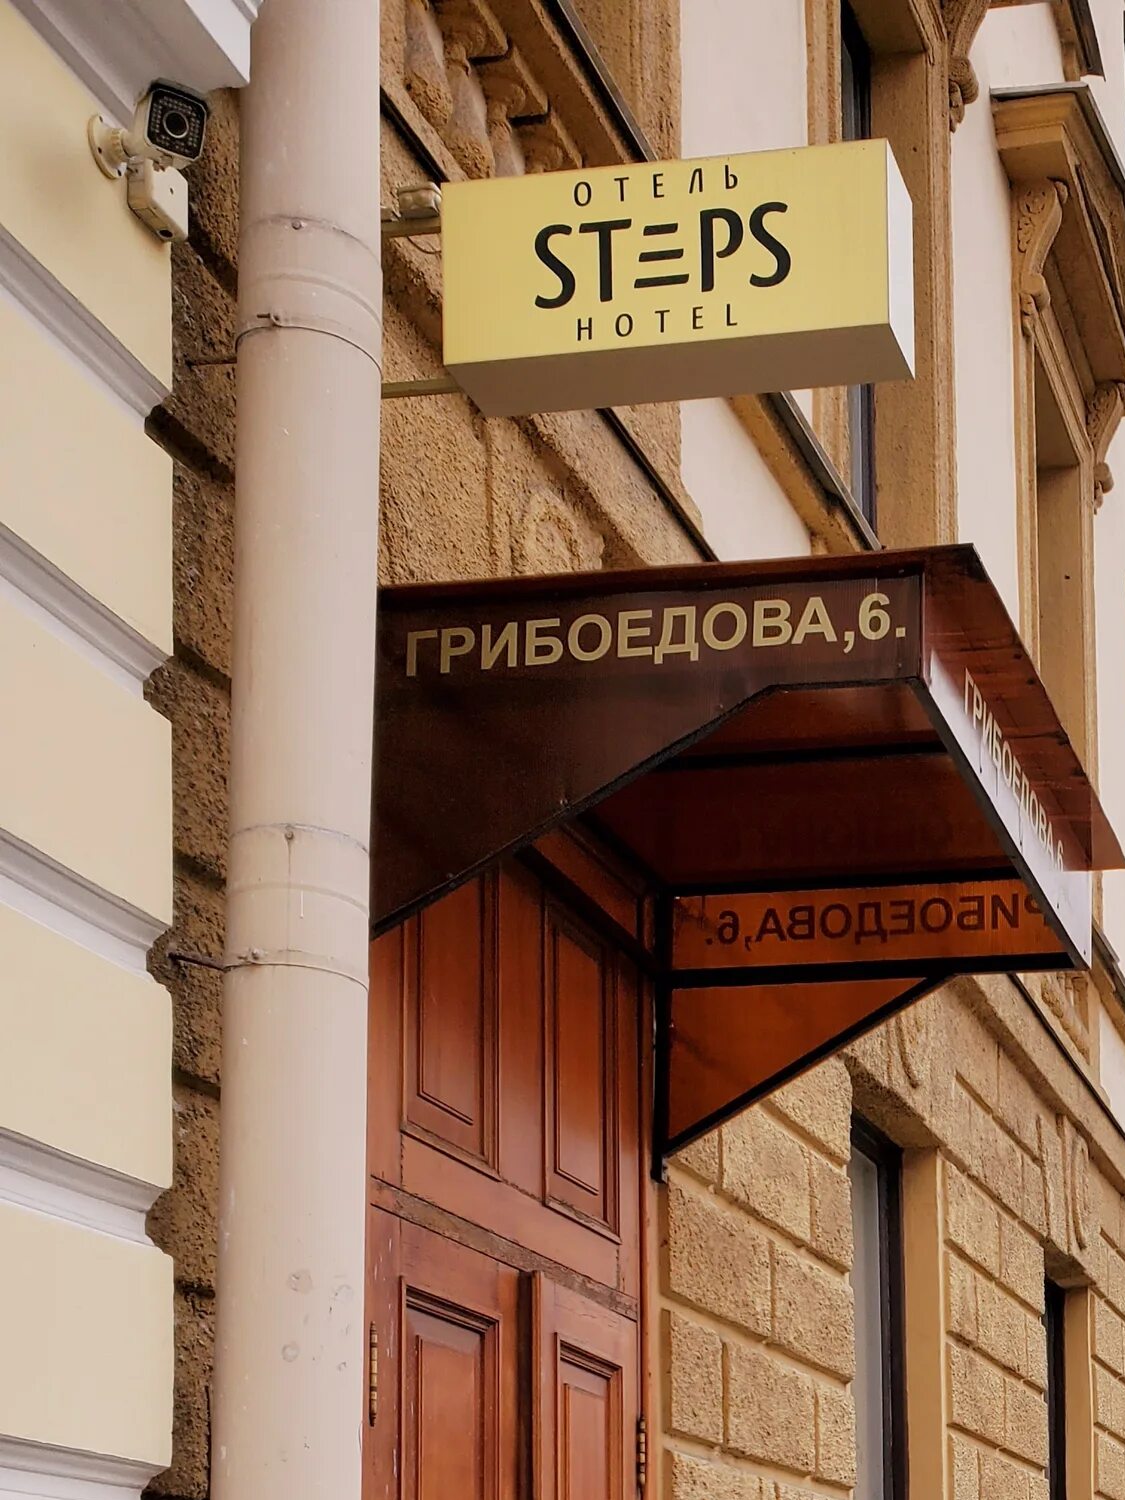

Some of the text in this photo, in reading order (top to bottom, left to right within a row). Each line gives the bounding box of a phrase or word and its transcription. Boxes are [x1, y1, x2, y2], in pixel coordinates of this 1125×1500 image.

[573, 164, 739, 208] ОТЕЛЬ
[534, 201, 792, 309] STEPS
[577, 303, 738, 342] HOTEL
